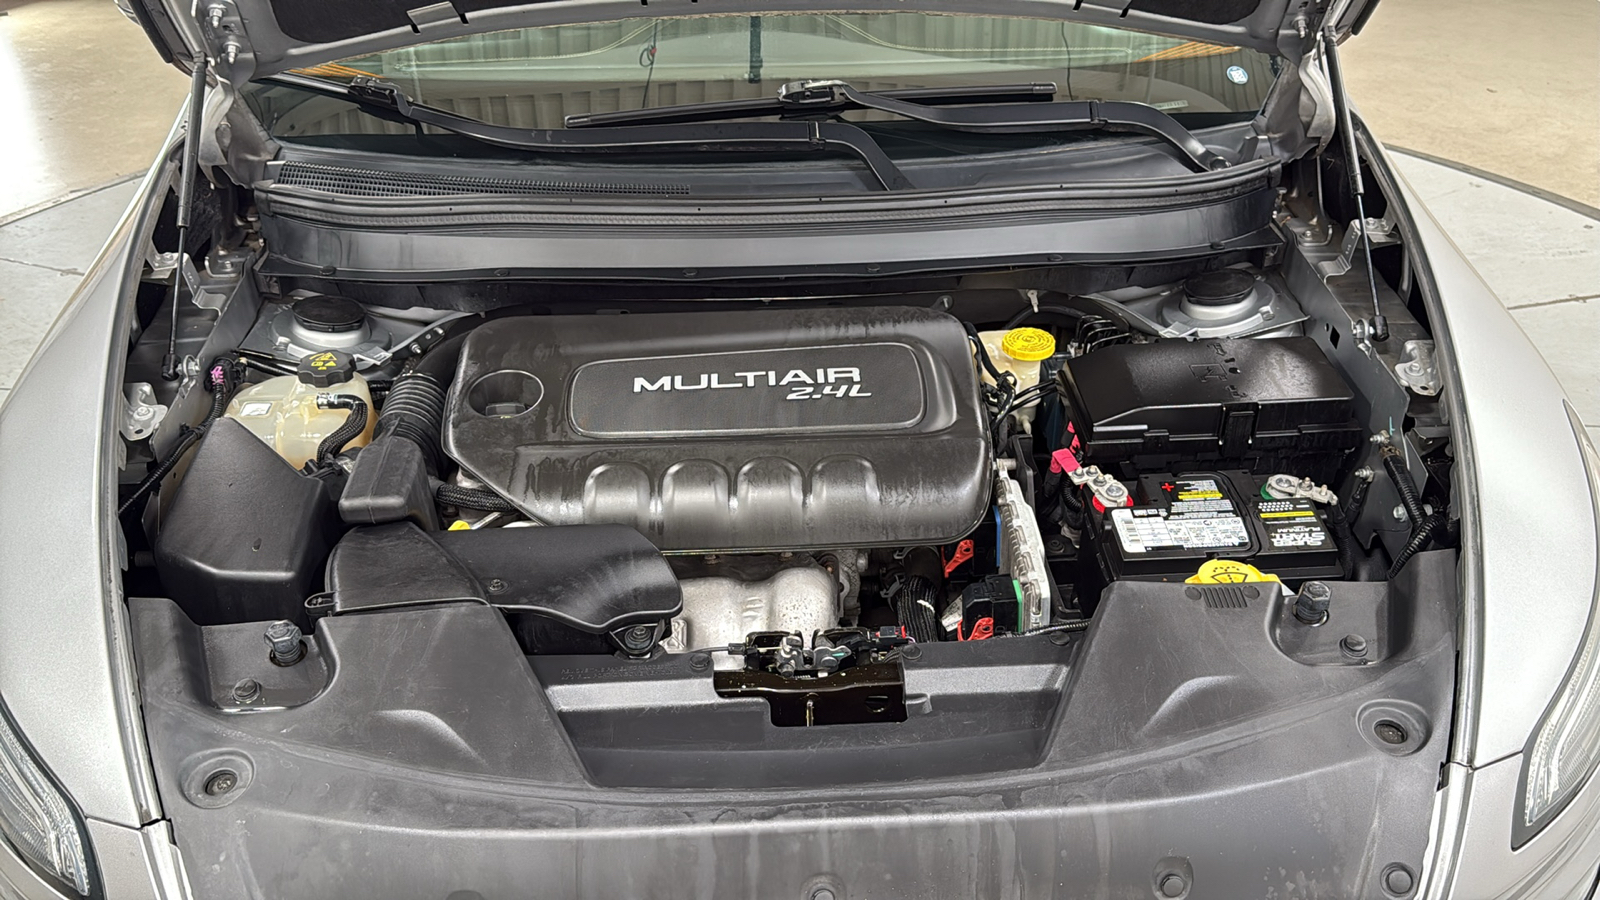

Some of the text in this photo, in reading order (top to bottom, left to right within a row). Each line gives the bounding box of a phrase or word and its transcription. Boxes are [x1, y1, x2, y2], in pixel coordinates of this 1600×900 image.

[633, 367, 861, 393] MULTIAIR
[786, 384, 872, 400] 2.4L
[1274, 532, 1326, 541] START
